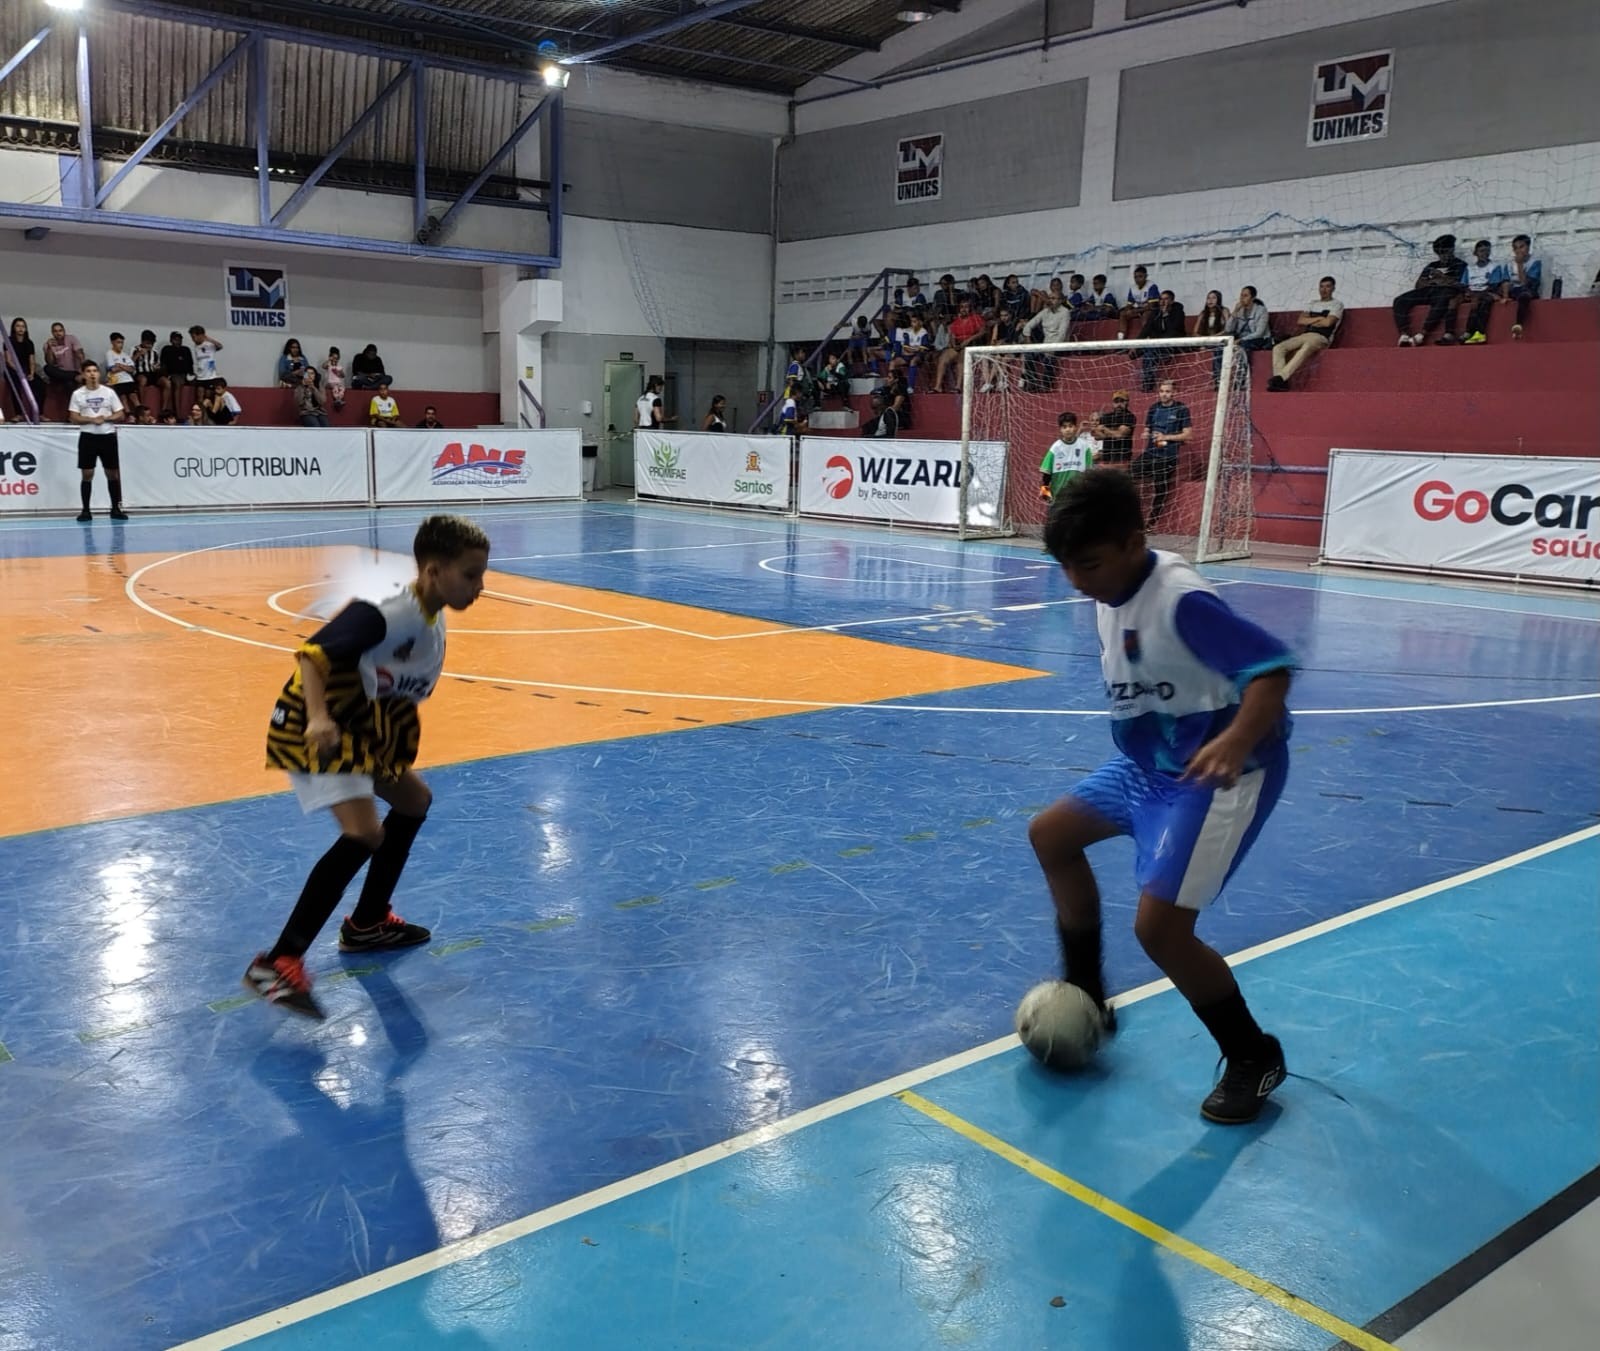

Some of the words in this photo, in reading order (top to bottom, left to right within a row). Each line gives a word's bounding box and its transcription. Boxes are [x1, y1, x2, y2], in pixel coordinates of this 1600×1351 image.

[1312, 112, 1384, 142] UNIMES
[898, 178, 939, 200] UNIMES
[231, 310, 286, 327] UNIMES
[173, 457, 322, 478] GRUPOTRIBUNA
[734, 479, 773, 495] Santos
[858, 487, 868, 503] by
[871, 488, 910, 502] Pearson
